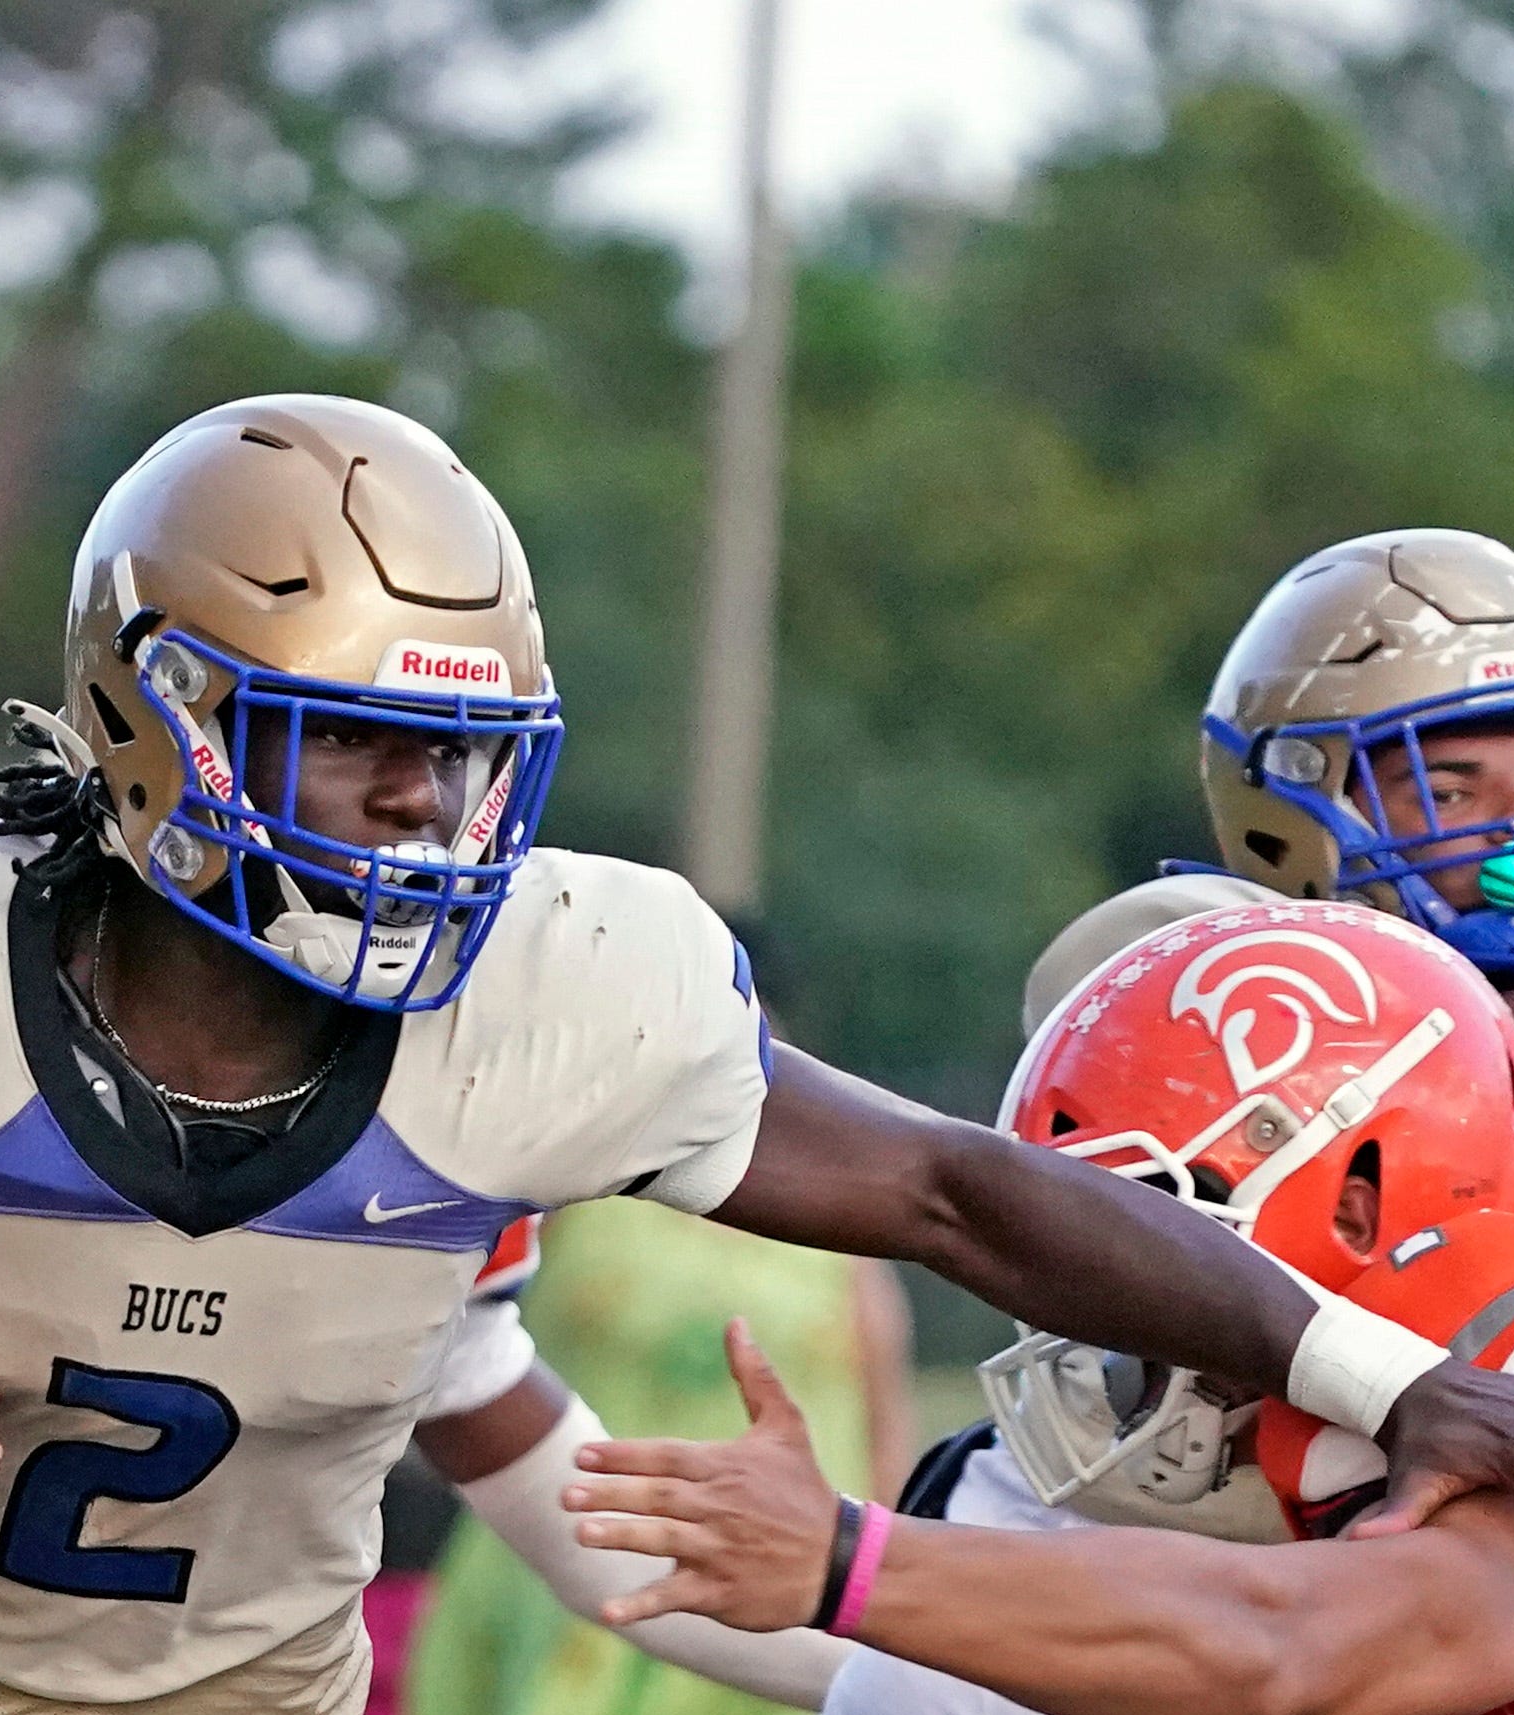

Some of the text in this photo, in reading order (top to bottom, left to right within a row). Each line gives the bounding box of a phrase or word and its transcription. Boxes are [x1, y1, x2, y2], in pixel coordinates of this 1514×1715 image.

[401, 650, 500, 684] Riddell
[369, 935, 417, 950] Riddell
[122, 1283, 228, 1336] BUCS
